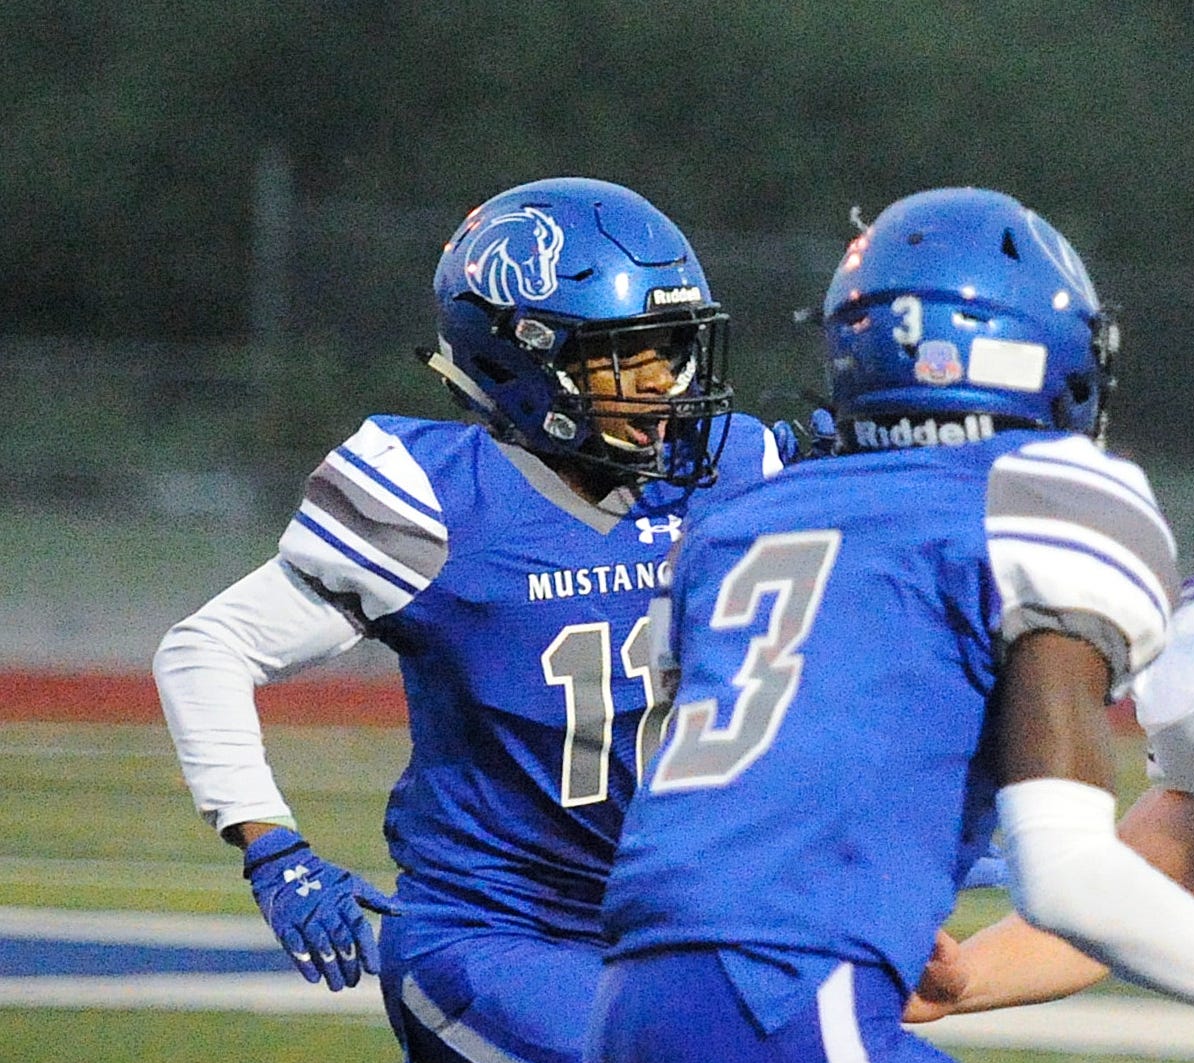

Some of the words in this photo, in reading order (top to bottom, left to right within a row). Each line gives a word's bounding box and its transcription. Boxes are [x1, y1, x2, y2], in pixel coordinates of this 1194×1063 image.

[891, 295, 923, 346] 3
[853, 413, 994, 448] Riddell
[540, 614, 676, 808] 11
[651, 528, 843, 796] 3
